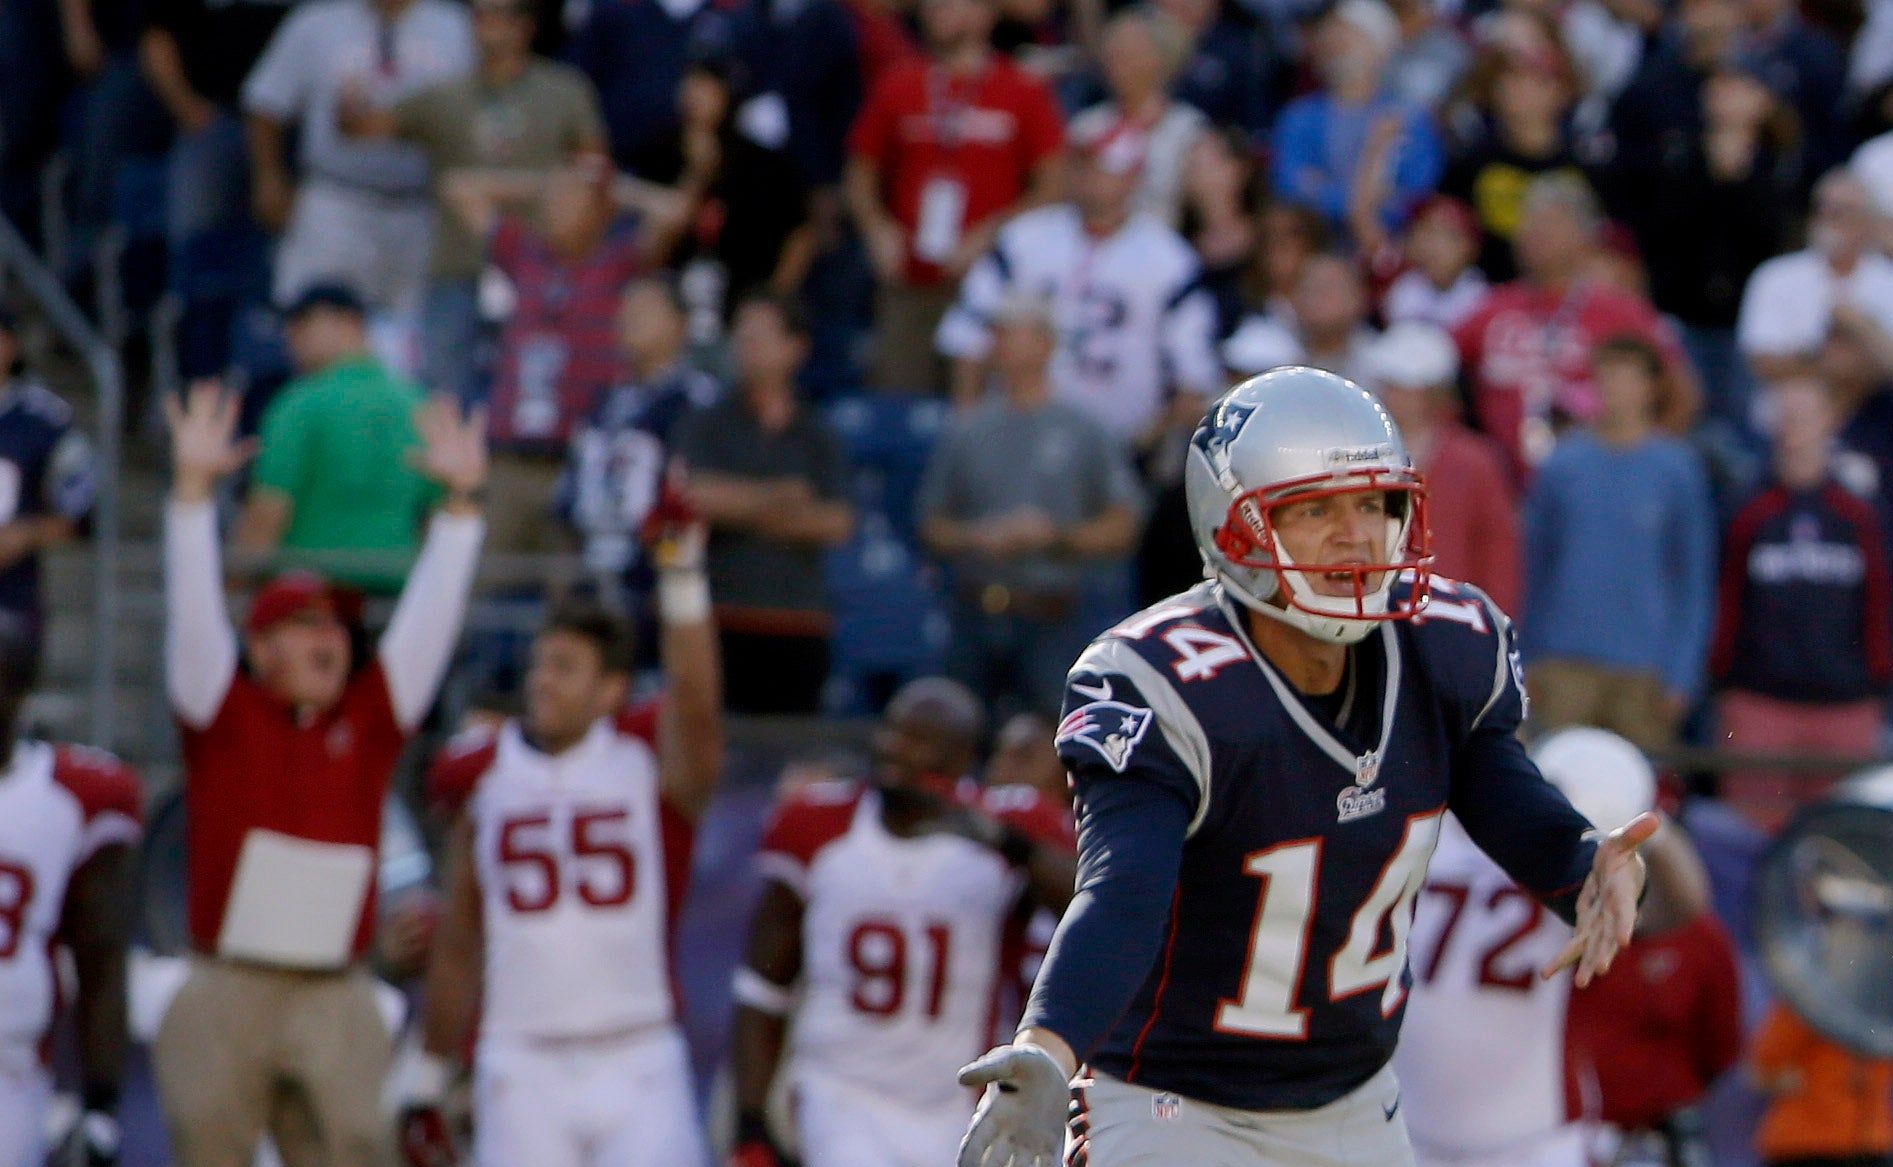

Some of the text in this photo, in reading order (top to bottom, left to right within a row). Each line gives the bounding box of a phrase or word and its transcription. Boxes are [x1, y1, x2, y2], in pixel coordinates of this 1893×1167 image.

[1109, 606, 1252, 685] 14
[497, 806, 637, 915] 55
[844, 918, 952, 1019] 91
[1213, 808, 1450, 1043] 14
[1420, 881, 1545, 992] 72
